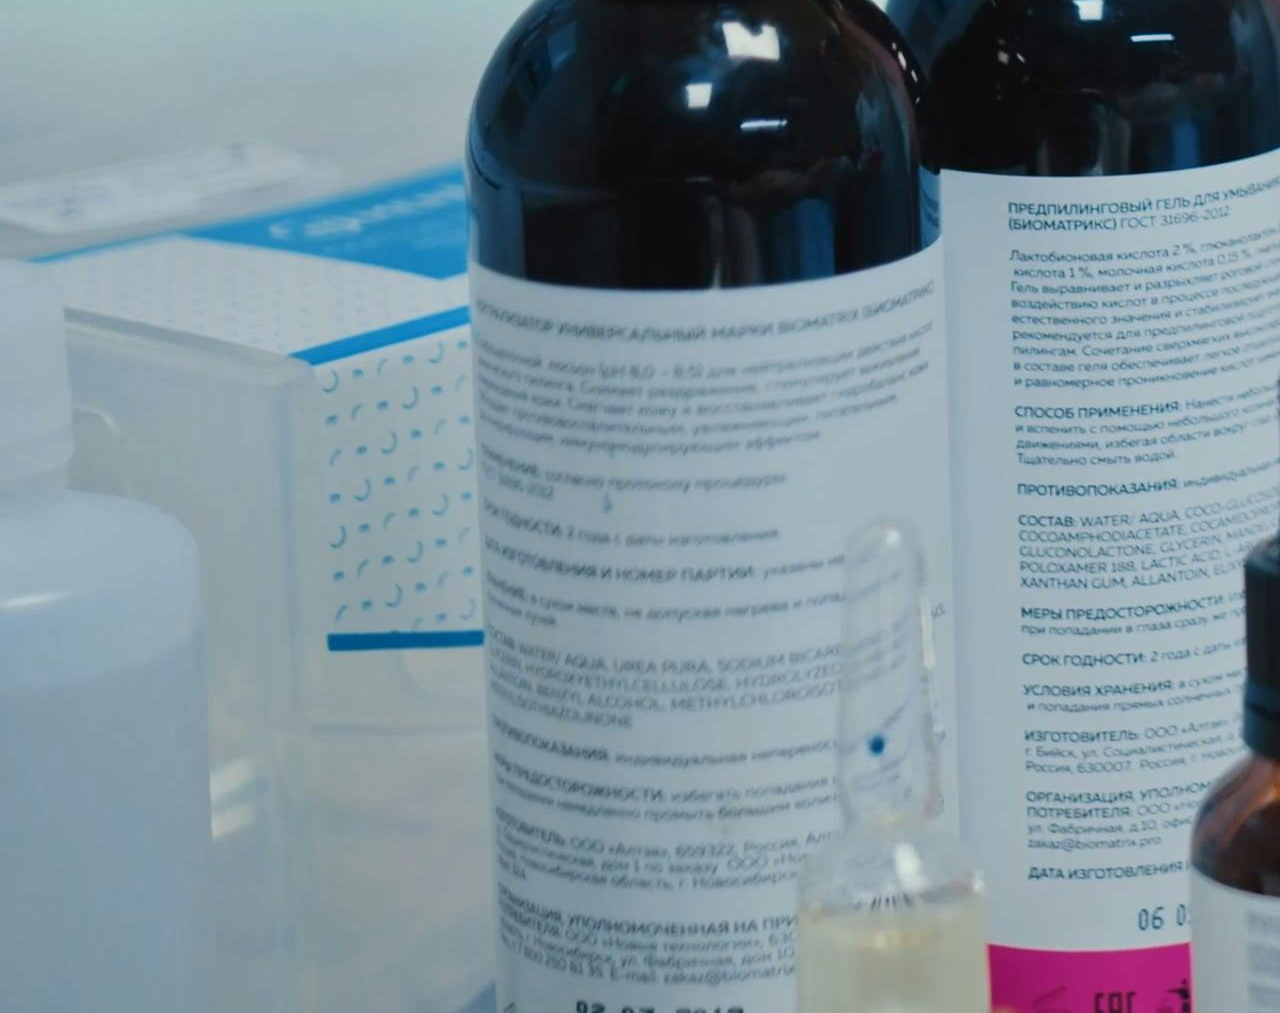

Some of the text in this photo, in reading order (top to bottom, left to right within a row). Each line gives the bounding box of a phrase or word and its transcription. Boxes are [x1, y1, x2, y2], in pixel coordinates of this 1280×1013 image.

[1008, 198, 1152, 217] ПРЕДПИЛИНГОВЫЙ
[1156, 197, 1191, 211] ГЕЛЬ
[1193, 190, 1221, 207] ДЛЯ
[1008, 219, 1117, 231] (БИОМАТРИКС)
[1120, 217, 1156, 229] ГОСТ
[1010, 249, 1113, 263] Лактобионовая
[1117, 248, 1169, 261] кислота
[1013, 267, 1065, 279] кислота
[1098, 265, 1163, 277] молочная
[1011, 281, 1038, 293] Гель
[1042, 281, 1130, 296] выравнивает
[1011, 299, 1098, 312] воздействию
[1102, 296, 1147, 308] кислот
[1011, 313, 1107, 326] естественного
[1111, 311, 1171, 323] значения
[1012, 329, 1113, 343] рекомендуется
[1116, 327, 1141, 340] для
[1082, 343, 1153, 357] Сочетание
[1024, 361, 1074, 373] составе
[1025, 376, 1115, 389] равномерное
[1014, 406, 1074, 418] СПОСОБ
[1078, 401, 1182, 418] ПРИМЕНЕНИЯ:
[1100, 421, 1164, 435] помощью
[1105, 436, 1157, 449] избегая
[1016, 453, 1087, 466] Тщательно
[1090, 452, 1131, 465] смыть
[1020, 561, 1107, 574] POLOXAMER
[1020, 576, 1089, 589] XANTHAN
[1021, 607, 1062, 620] МЕРЫ
[1021, 625, 1045, 635] при
[1049, 625, 1122, 637] попадании
[1022, 653, 1060, 666] СРОК
[1064, 653, 1146, 667] ГОДНОСТИ:
[1024, 685, 1090, 696] УСЛОВИЯ
[1026, 762, 1073, 773] Россия,
[1028, 861, 1182, 879] ДАТА ИЗГОТОВЛЕНИЯ
[1137, 906, 1164, 930] 06
